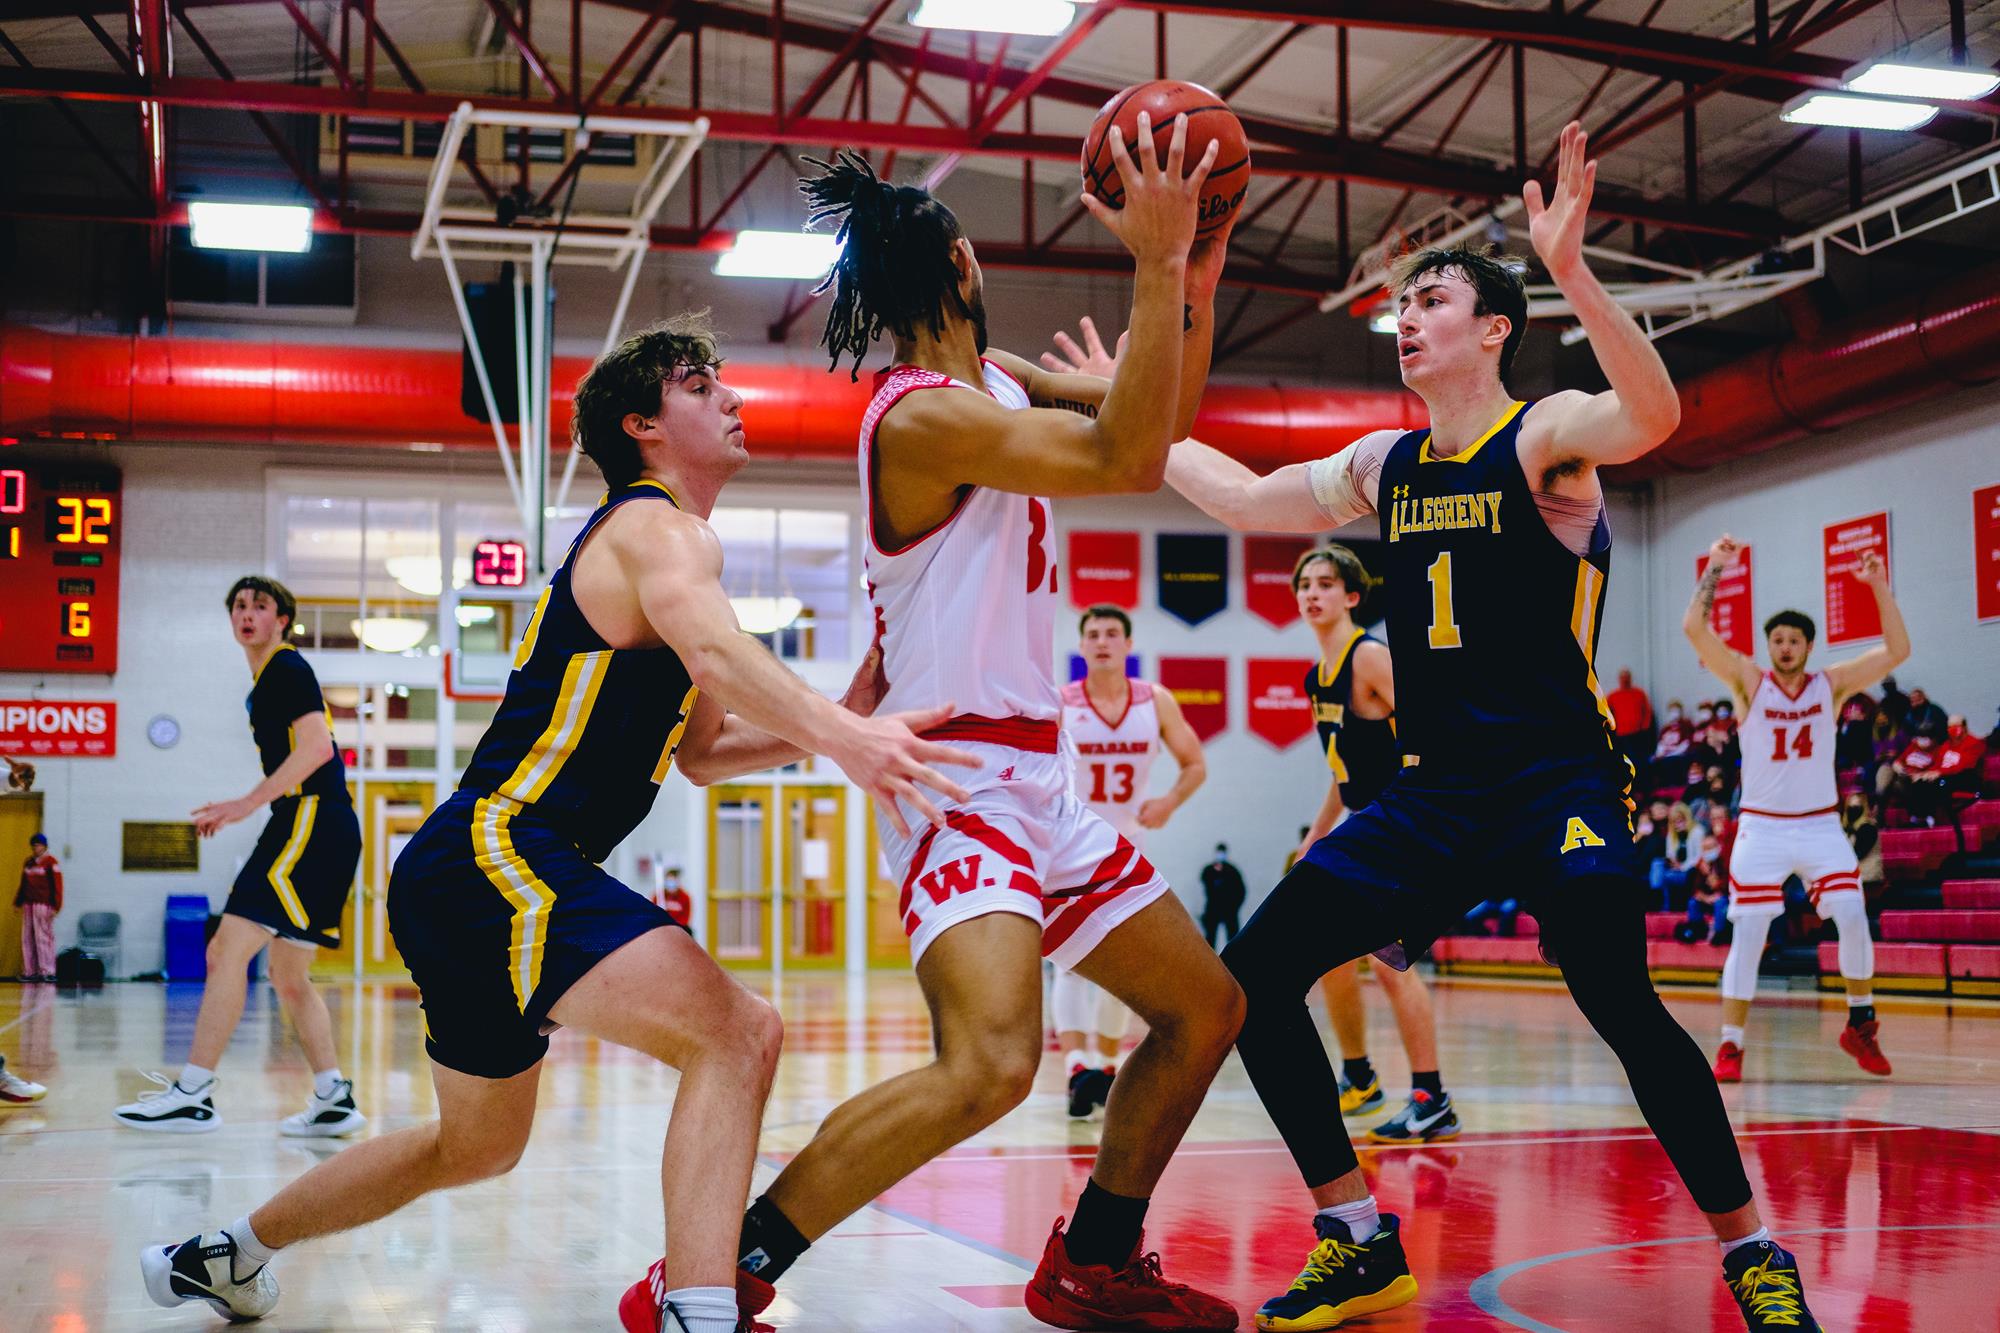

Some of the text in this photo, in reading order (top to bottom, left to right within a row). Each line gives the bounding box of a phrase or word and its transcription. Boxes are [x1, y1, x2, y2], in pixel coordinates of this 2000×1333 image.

[57, 498, 111, 544] 32
[1389, 491, 1502, 543] ALLEGHENY
[476, 543, 524, 585] 23
[69, 602, 91, 637] 6
[1427, 551, 1463, 649] 1
[0, 705, 108, 734] PIONS
[1771, 724, 1814, 762] 14
[1089, 763, 1135, 804] 13
[1560, 816, 1606, 855] A
[206, 1247, 228, 1256] CURRY
